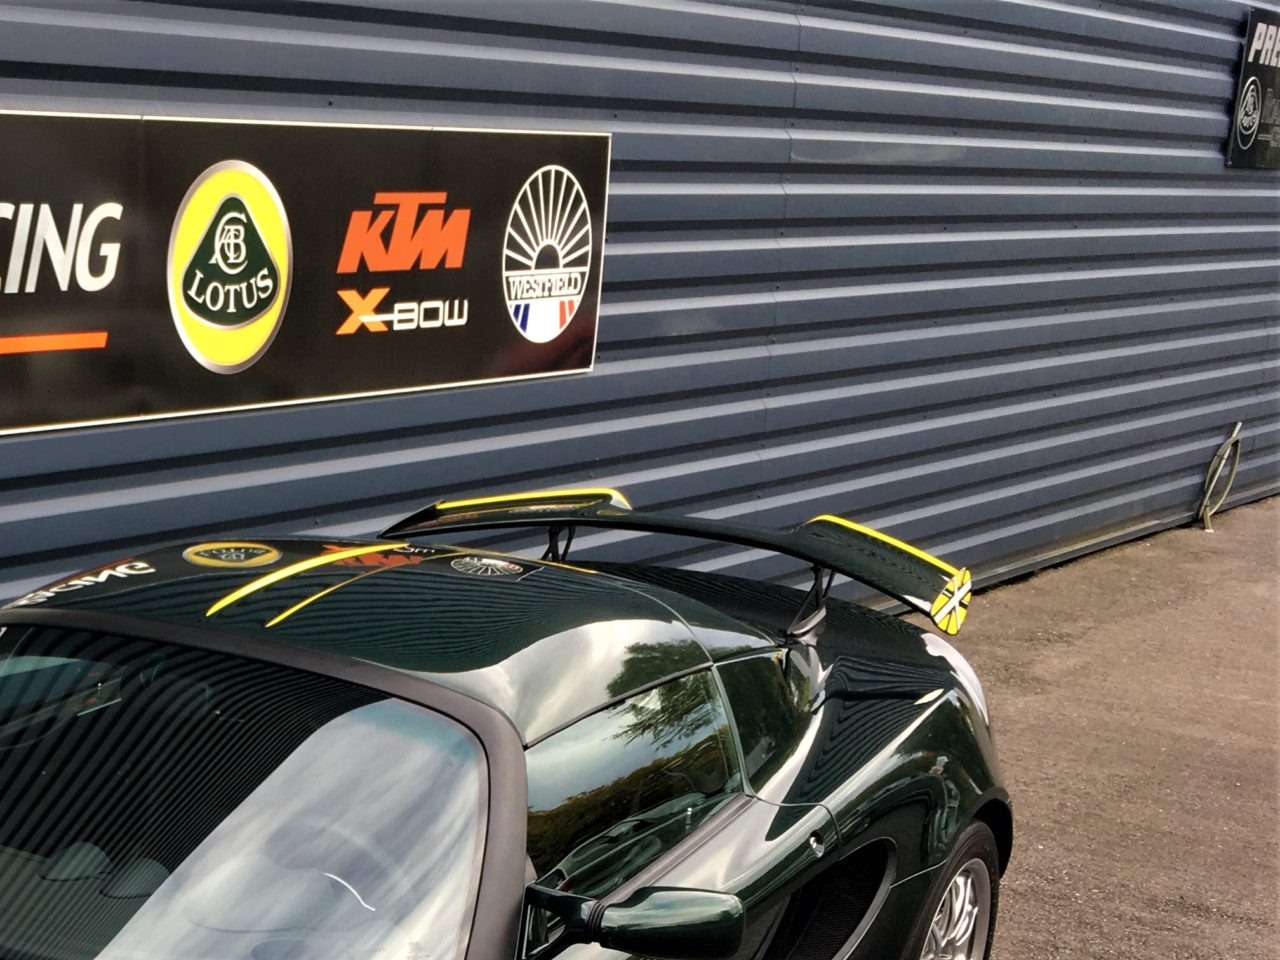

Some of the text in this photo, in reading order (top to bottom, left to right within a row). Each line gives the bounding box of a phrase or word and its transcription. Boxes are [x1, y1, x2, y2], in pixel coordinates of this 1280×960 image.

[336, 192, 472, 274] KTM
[187, 267, 274, 313] LOTUS
[508, 271, 582, 301] WESTFIELD
